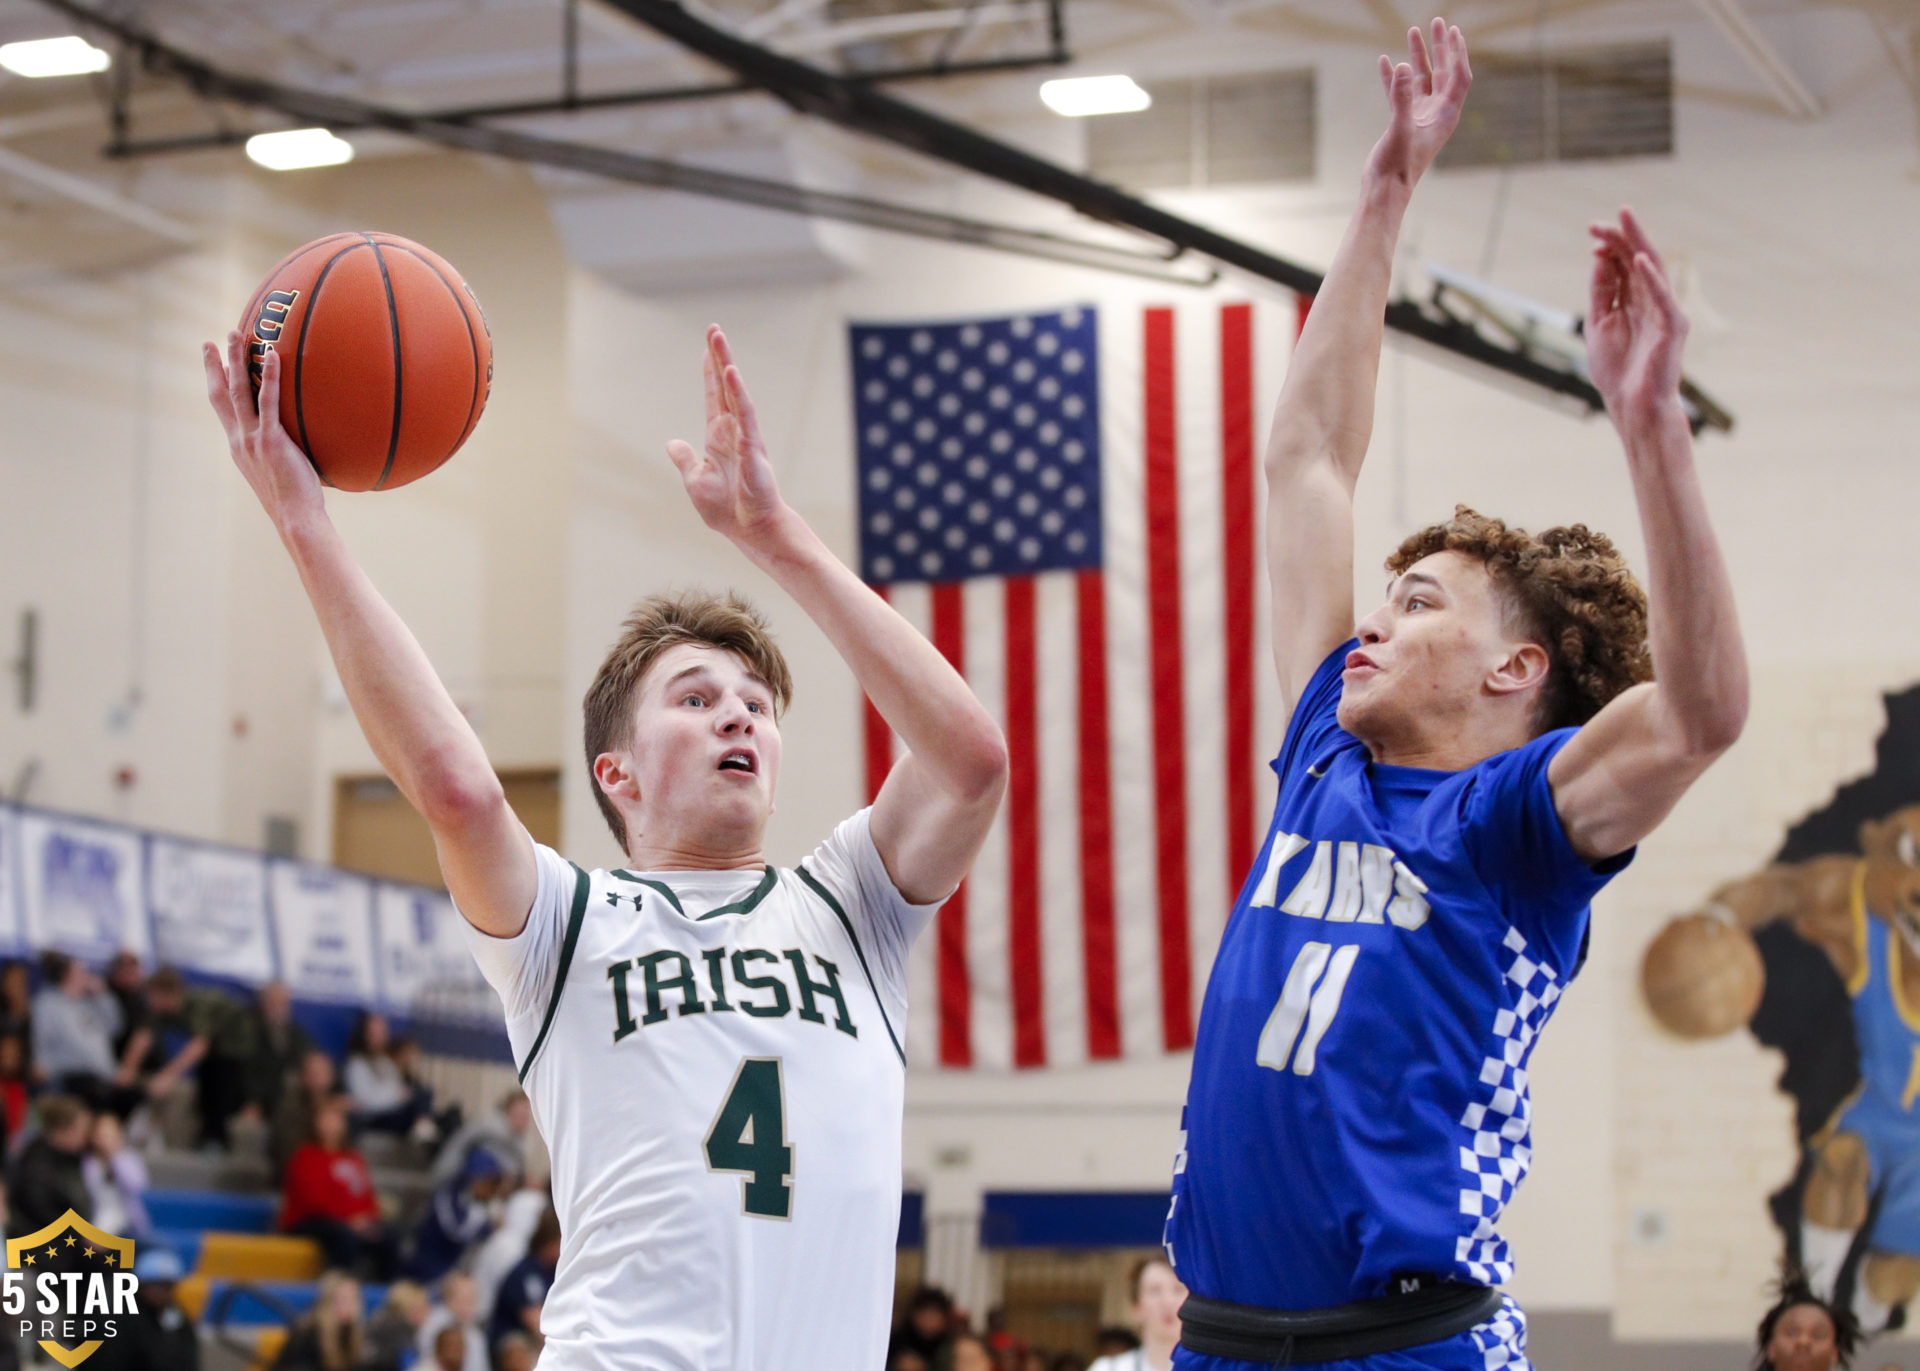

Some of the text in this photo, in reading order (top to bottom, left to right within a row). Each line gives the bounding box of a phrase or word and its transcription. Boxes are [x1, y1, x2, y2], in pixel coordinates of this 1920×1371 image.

[607, 946, 859, 1043] IRISH
[1256, 941, 1360, 1076] 11
[702, 1055, 796, 1222] 4
[1399, 1277, 1420, 1295] M
